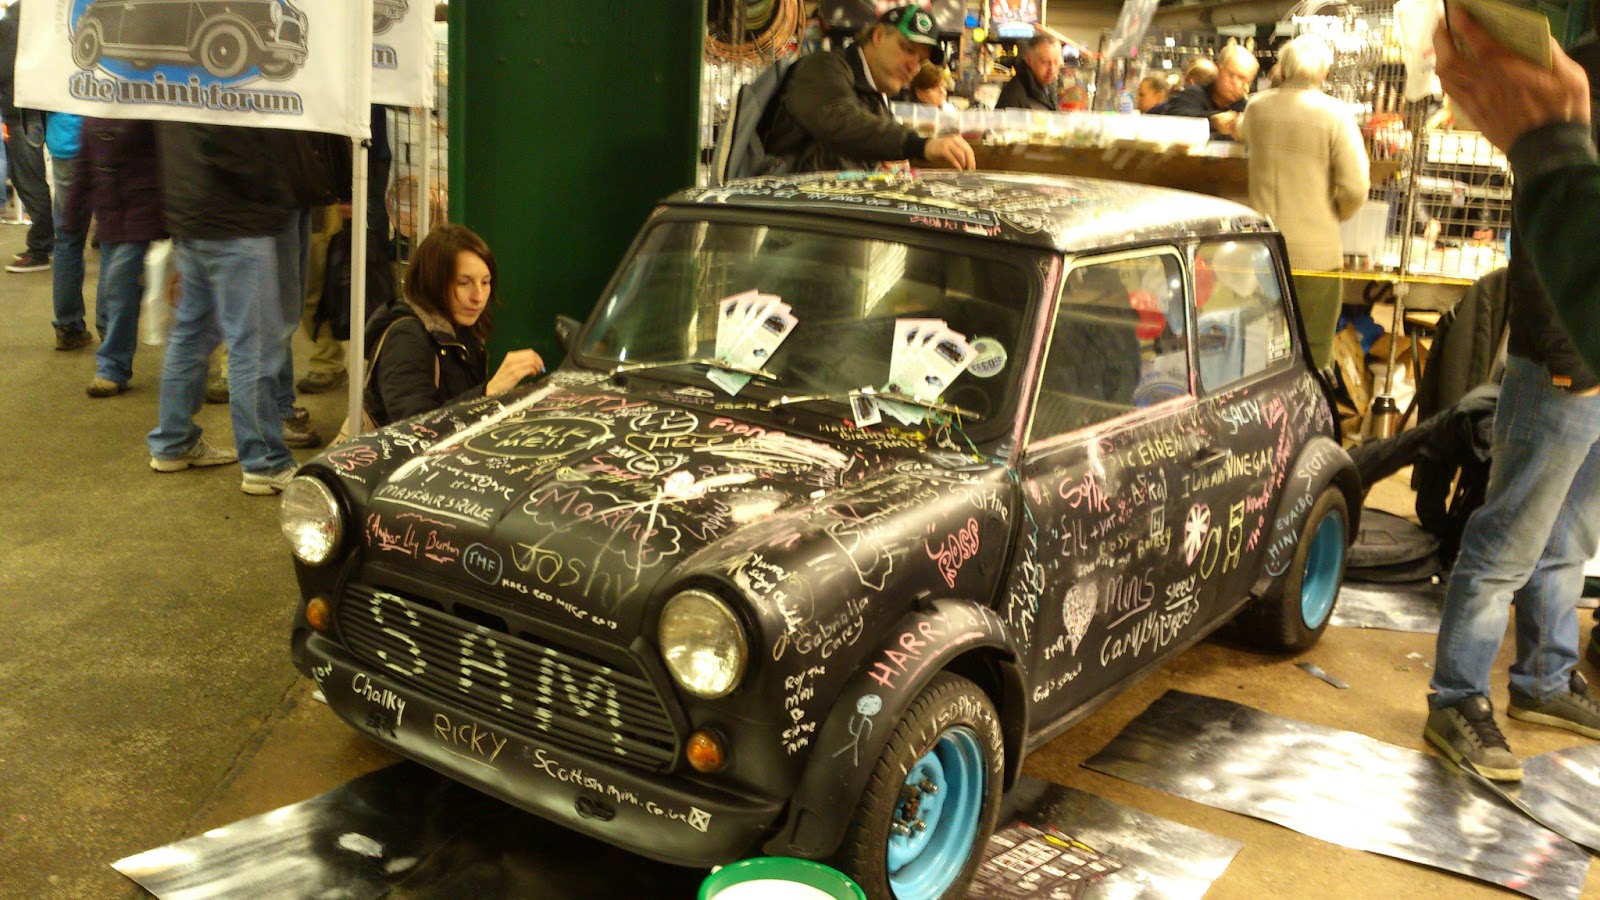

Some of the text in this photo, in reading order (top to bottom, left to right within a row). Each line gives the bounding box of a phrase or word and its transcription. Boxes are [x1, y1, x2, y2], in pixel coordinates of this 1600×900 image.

[70, 70, 303, 114] the mini forum
[490, 424, 591, 440] CHALK
[1221, 399, 1262, 434] SALTY
[469, 550, 496, 573] TMF
[1269, 529, 1298, 560] MINI
[869, 612, 951, 689] HARRY
[370, 592, 628, 757] SAM
[351, 672, 407, 727] Chalky
